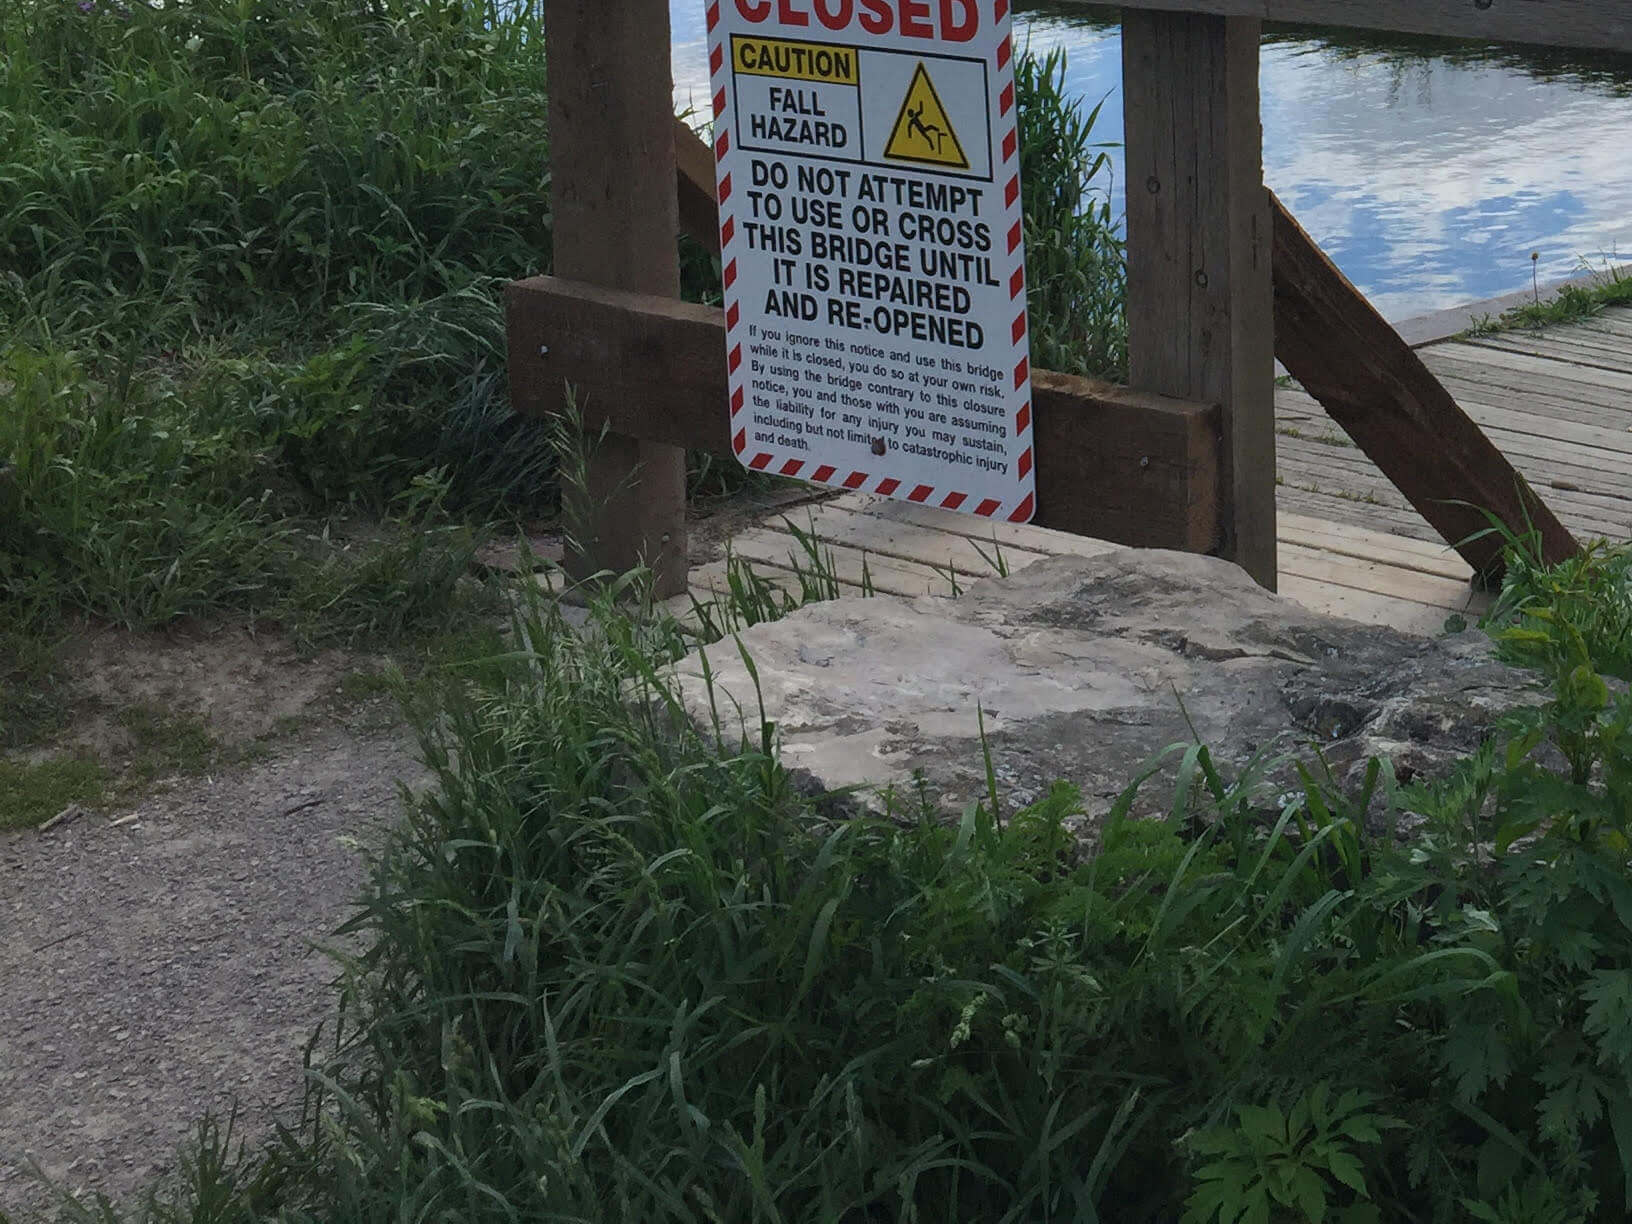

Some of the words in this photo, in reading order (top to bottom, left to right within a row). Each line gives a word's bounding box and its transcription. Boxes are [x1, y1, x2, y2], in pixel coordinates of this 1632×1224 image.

[739, 44, 850, 78] CAUTION
[769, 87, 825, 116] FALL
[751, 114, 847, 148] HAZARD
[751, 160, 788, 189] DO
[798, 165, 850, 197] NOT
[858, 174, 983, 216] ATTEMPT
[747, 191, 782, 220] TO
[792, 197, 842, 229] USE
[852, 205, 889, 236] OR
[899, 212, 991, 251] CROSS
[743, 222, 801, 255] THIS
[812, 232, 910, 272] BRIDGE
[921, 248, 1000, 286] UNTIL
[774, 258, 796, 286] IT
[806, 263, 829, 291] IS
[840, 268, 971, 315] REPAIRED
[765, 289, 817, 321] AND
[828, 299, 983, 349] RE-OPENED
[750, 324, 756, 336] If
[761, 329, 780, 340] you
[786, 331, 820, 347] ignore
[825, 338, 844, 351] this
[850, 344, 884, 358] notice
[890, 351, 910, 363] and
[916, 356, 935, 367] use
[941, 358, 961, 372] this
[967, 362, 1003, 381] bridge
[751, 344, 777, 357] while
[782, 348, 789, 359] it
[793, 349, 802, 361] is
[806, 353, 845, 371] closed,
[849, 362, 868, 373] you
[873, 364, 886, 376] do
[891, 369, 904, 379] so
[909, 371, 919, 382] at
[923, 375, 948, 387] your
[952, 381, 975, 392] own
[981, 384, 1004, 398] risk.
[752, 360, 764, 375] By
[770, 365, 799, 381] using
[805, 370, 822, 382] the
[828, 373, 862, 391] bridge
[867, 383, 914, 402] contrary
[920, 390, 931, 402] to
[937, 394, 957, 407] this
[964, 399, 1005, 417] closure
[752, 380, 788, 395] notice,
[792, 387, 812, 398] you
[817, 391, 836, 403] and
[841, 394, 871, 409] those
[876, 401, 900, 415] with
[904, 407, 924, 419] you
[929, 412, 946, 423] are
[952, 417, 1006, 438] assuming
[753, 396, 769, 408] the
[776, 399, 814, 418] liability
[821, 407, 836, 420] for
[843, 413, 862, 427] any
[868, 418, 899, 434] injury
[906, 424, 925, 437] you
[932, 431, 955, 445] may
[963, 436, 1007, 455] sustain,
[754, 412, 802, 433] including
[806, 422, 823, 435] but
[827, 428, 844, 440] not
[888, 438, 898, 449] to
[903, 443, 973, 464] catastrophic
[976, 457, 1008, 474] injury
[755, 432, 774, 443] and
